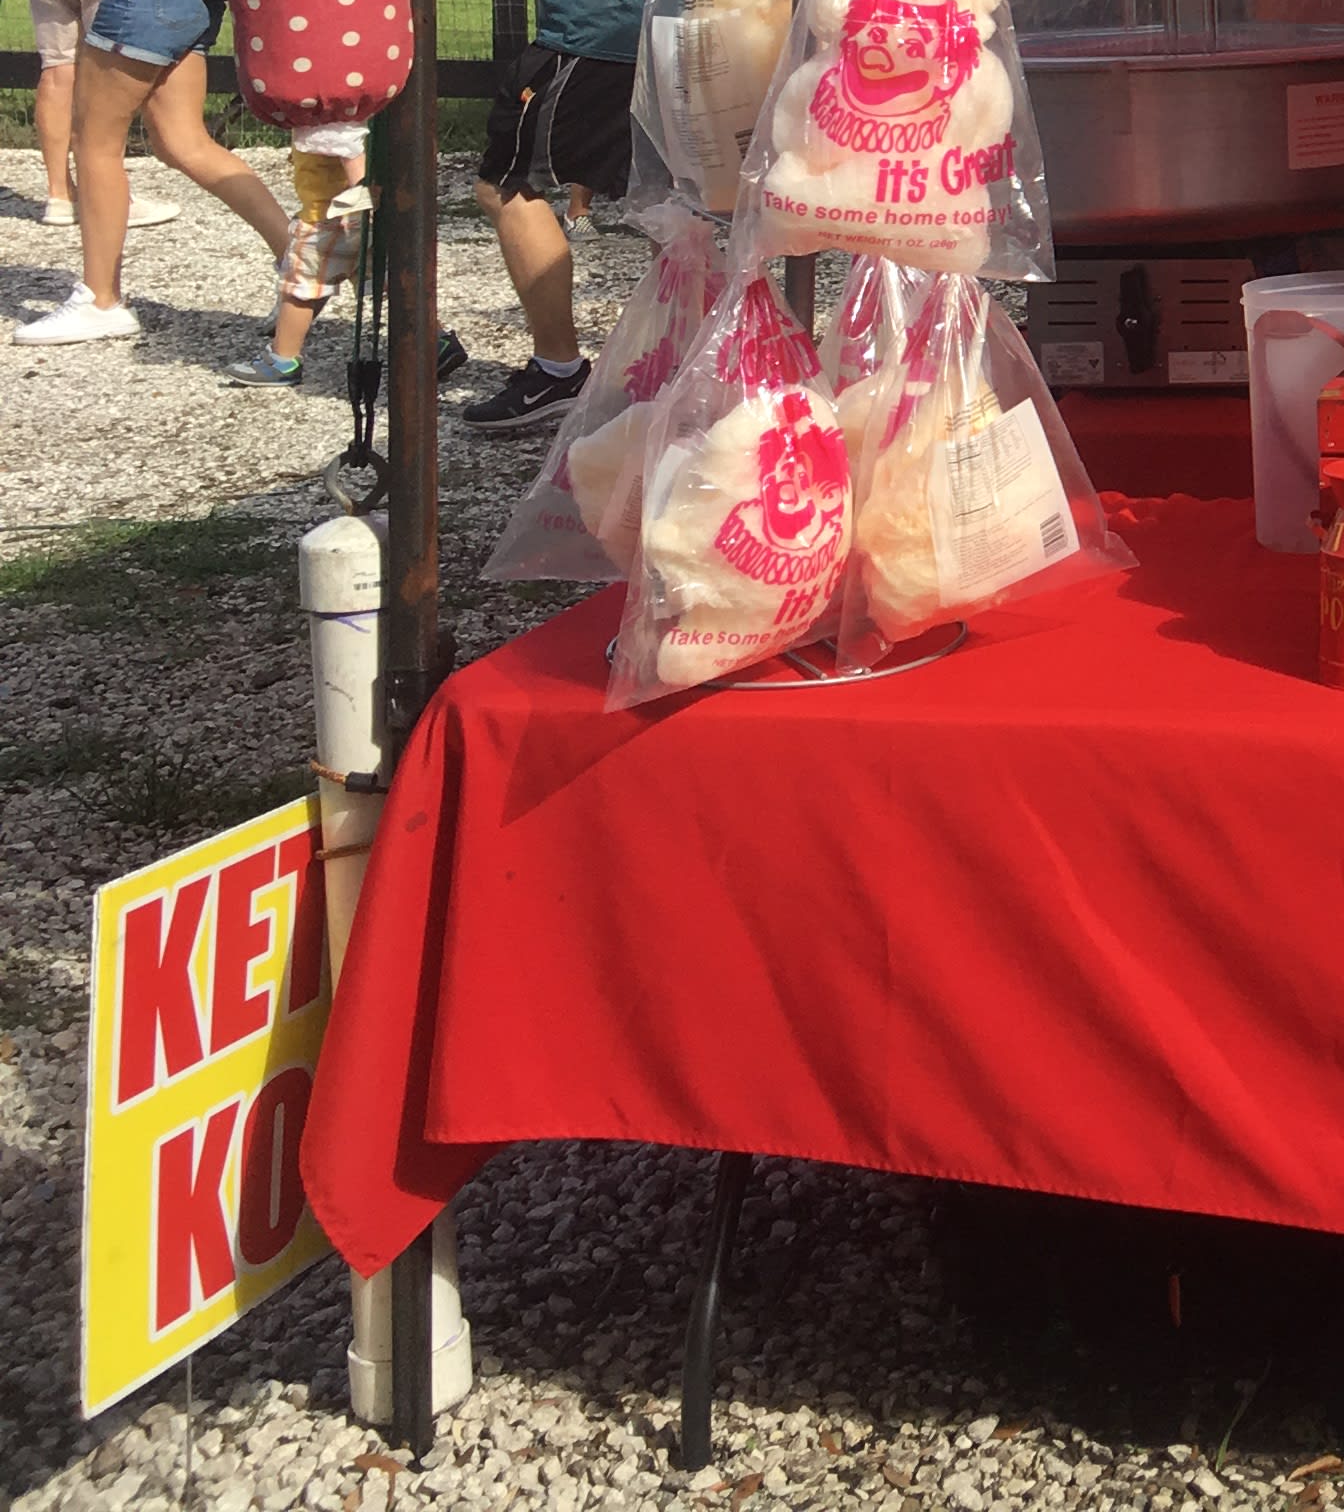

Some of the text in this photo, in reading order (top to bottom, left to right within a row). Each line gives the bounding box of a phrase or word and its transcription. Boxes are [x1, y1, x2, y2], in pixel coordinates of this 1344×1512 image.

[940, 133, 1017, 196] Great
[762, 190, 1013, 226] Take some home today!
[668, 628, 714, 646] Take
[717, 630, 771, 647] some
